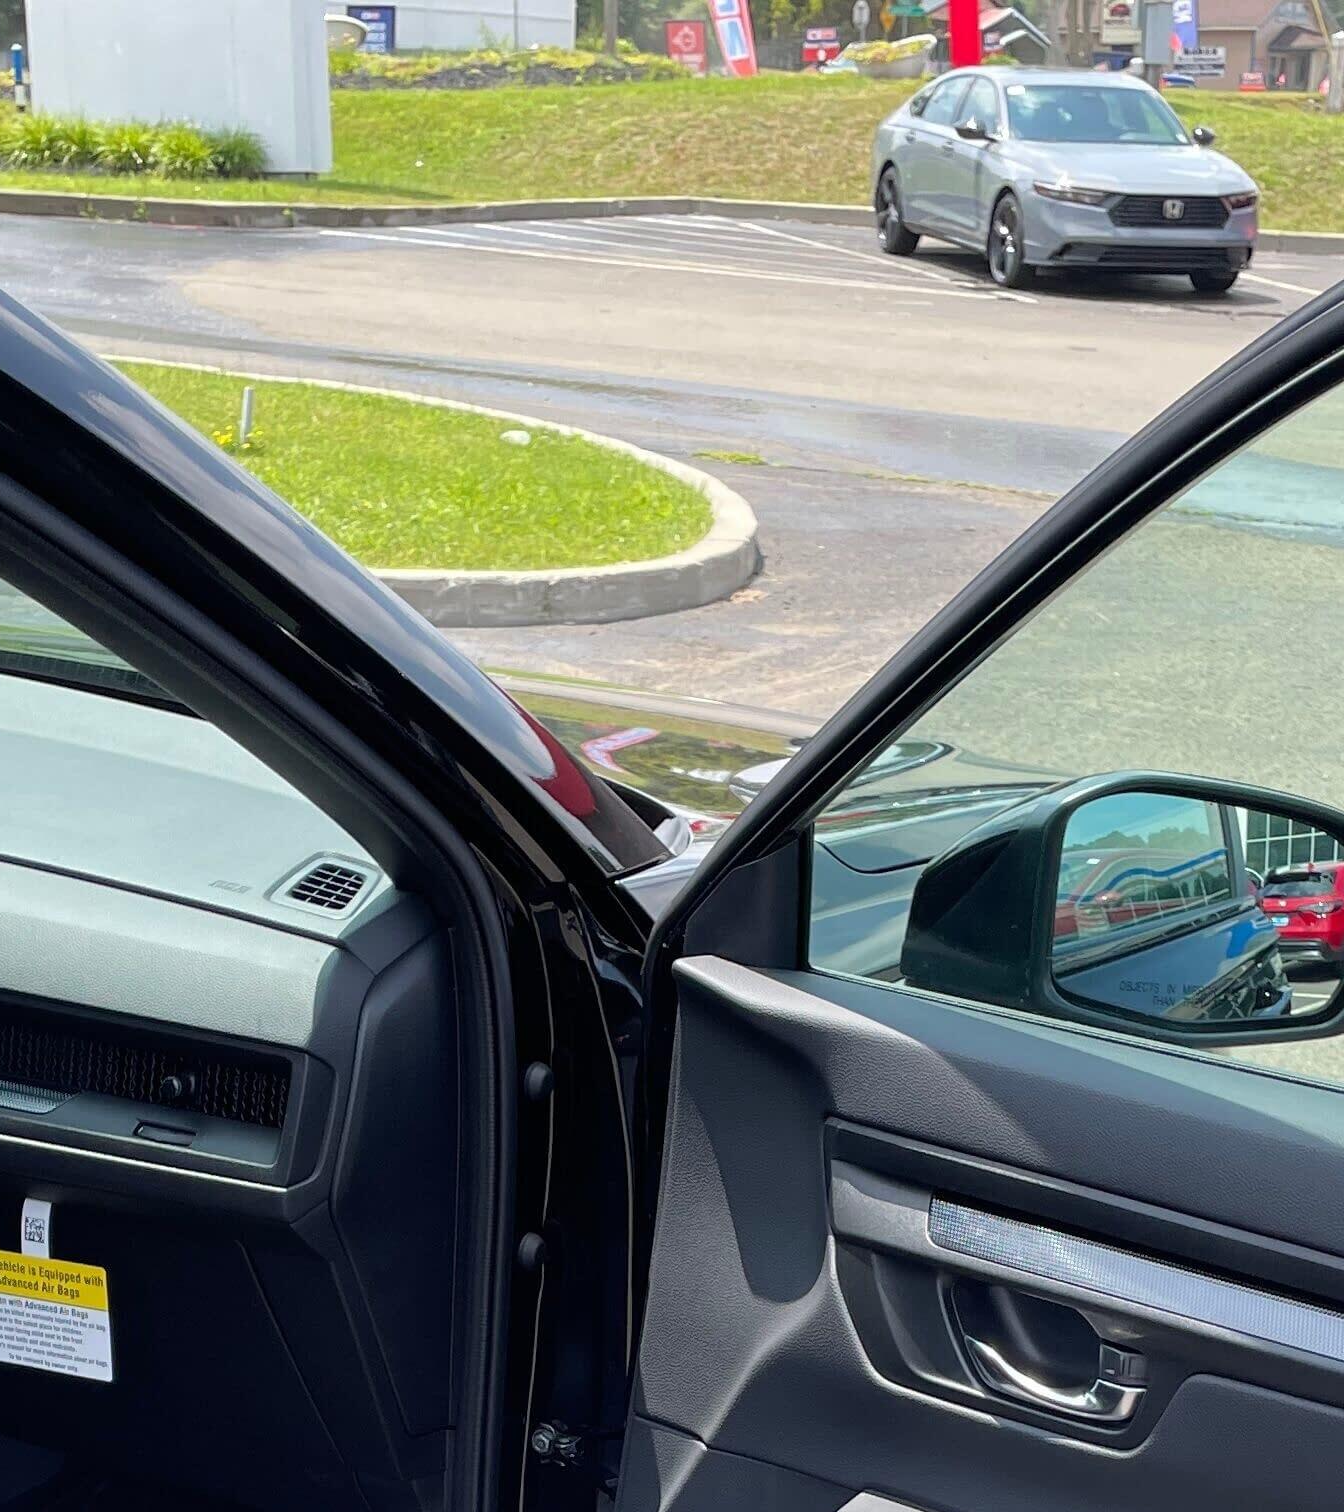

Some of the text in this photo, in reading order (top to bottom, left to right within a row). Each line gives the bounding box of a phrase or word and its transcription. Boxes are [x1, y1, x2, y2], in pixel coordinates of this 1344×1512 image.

[1119, 980, 1160, 994] OBJECTS
[28, 1264, 36, 1276] is
[39, 1265, 81, 1284] Equipped
[83, 1273, 104, 1287] with
[41, 1281, 55, 1294] Air
[57, 1284, 80, 1300] Bags
[9, 1298, 23, 1308] with
[24, 1300, 58, 1314] Advanced
[59, 1305, 70, 1315] Air
[71, 1308, 89, 1320] Bags
